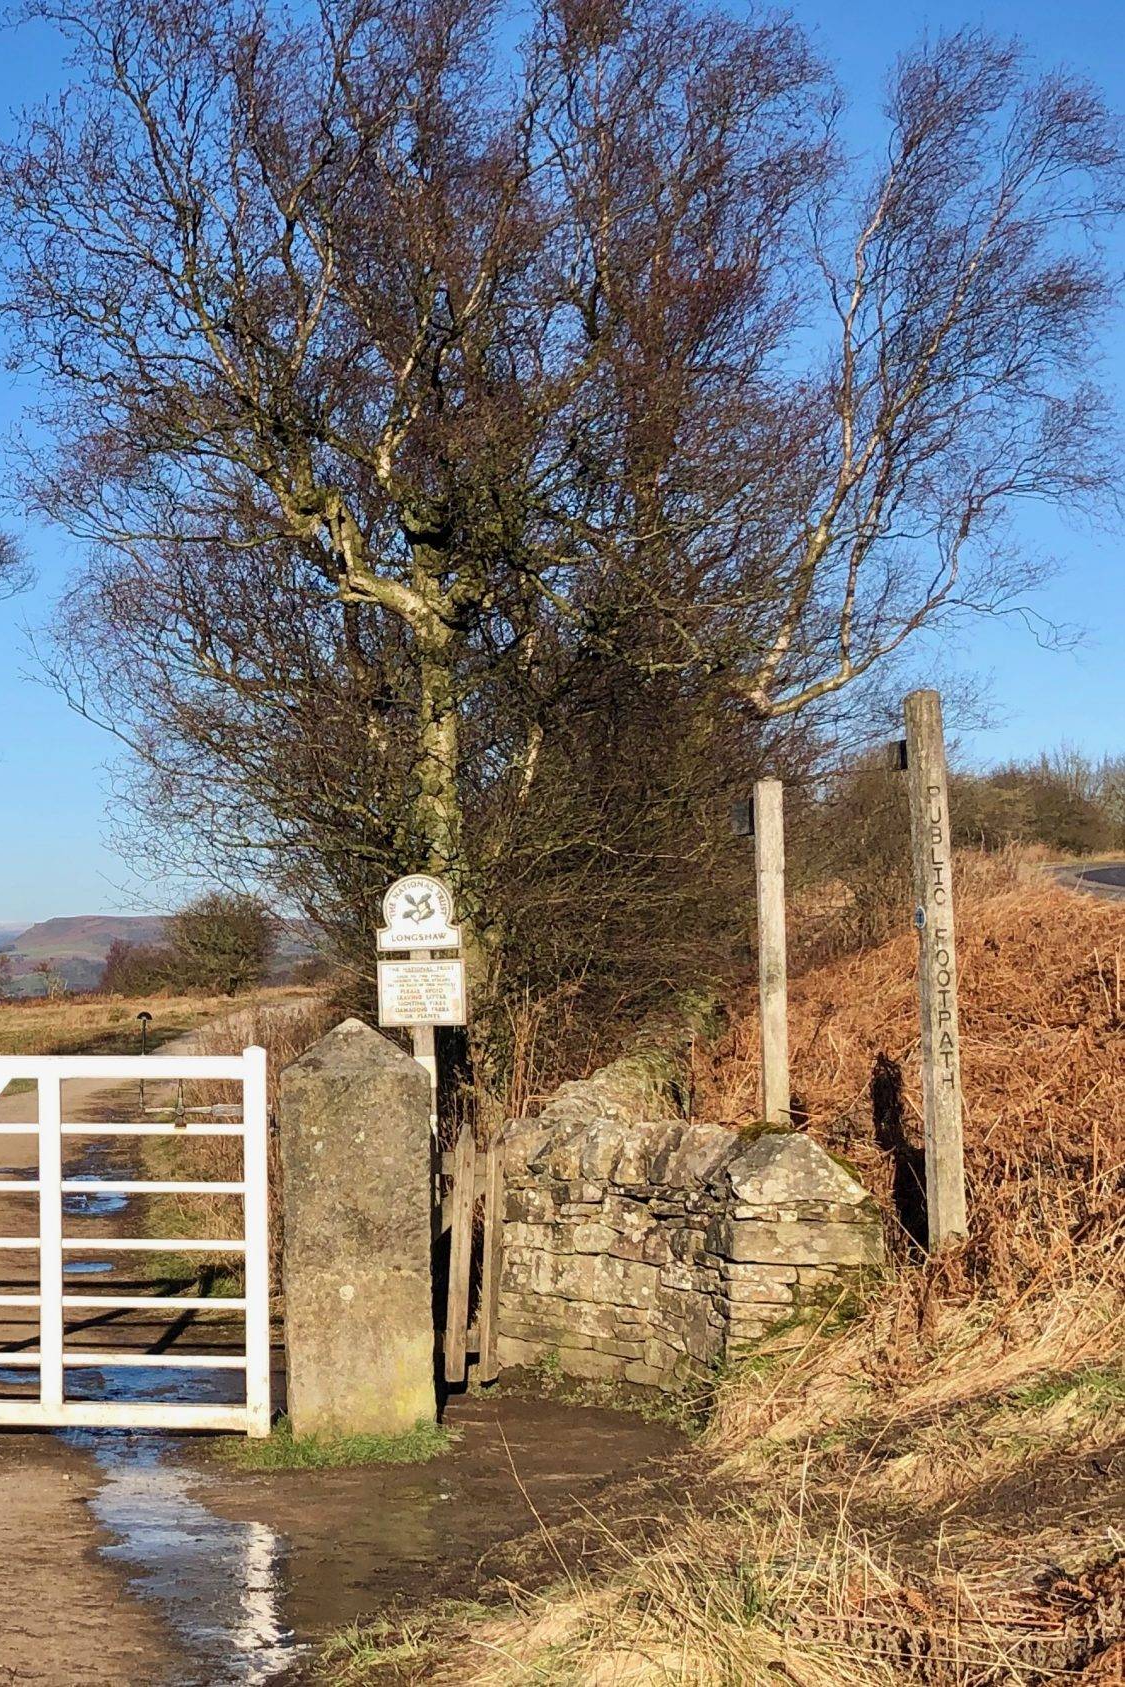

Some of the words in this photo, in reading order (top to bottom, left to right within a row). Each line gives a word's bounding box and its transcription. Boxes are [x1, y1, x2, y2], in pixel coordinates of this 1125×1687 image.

[926, 785, 946, 906] PUBLIC
[388, 902, 396, 919] THE
[393, 881, 434, 900] NATIONAL
[435, 891, 447, 916] TRUST
[391, 932, 447, 942] LONGSHAW
[934, 928, 955, 1090] FOOTPATH
